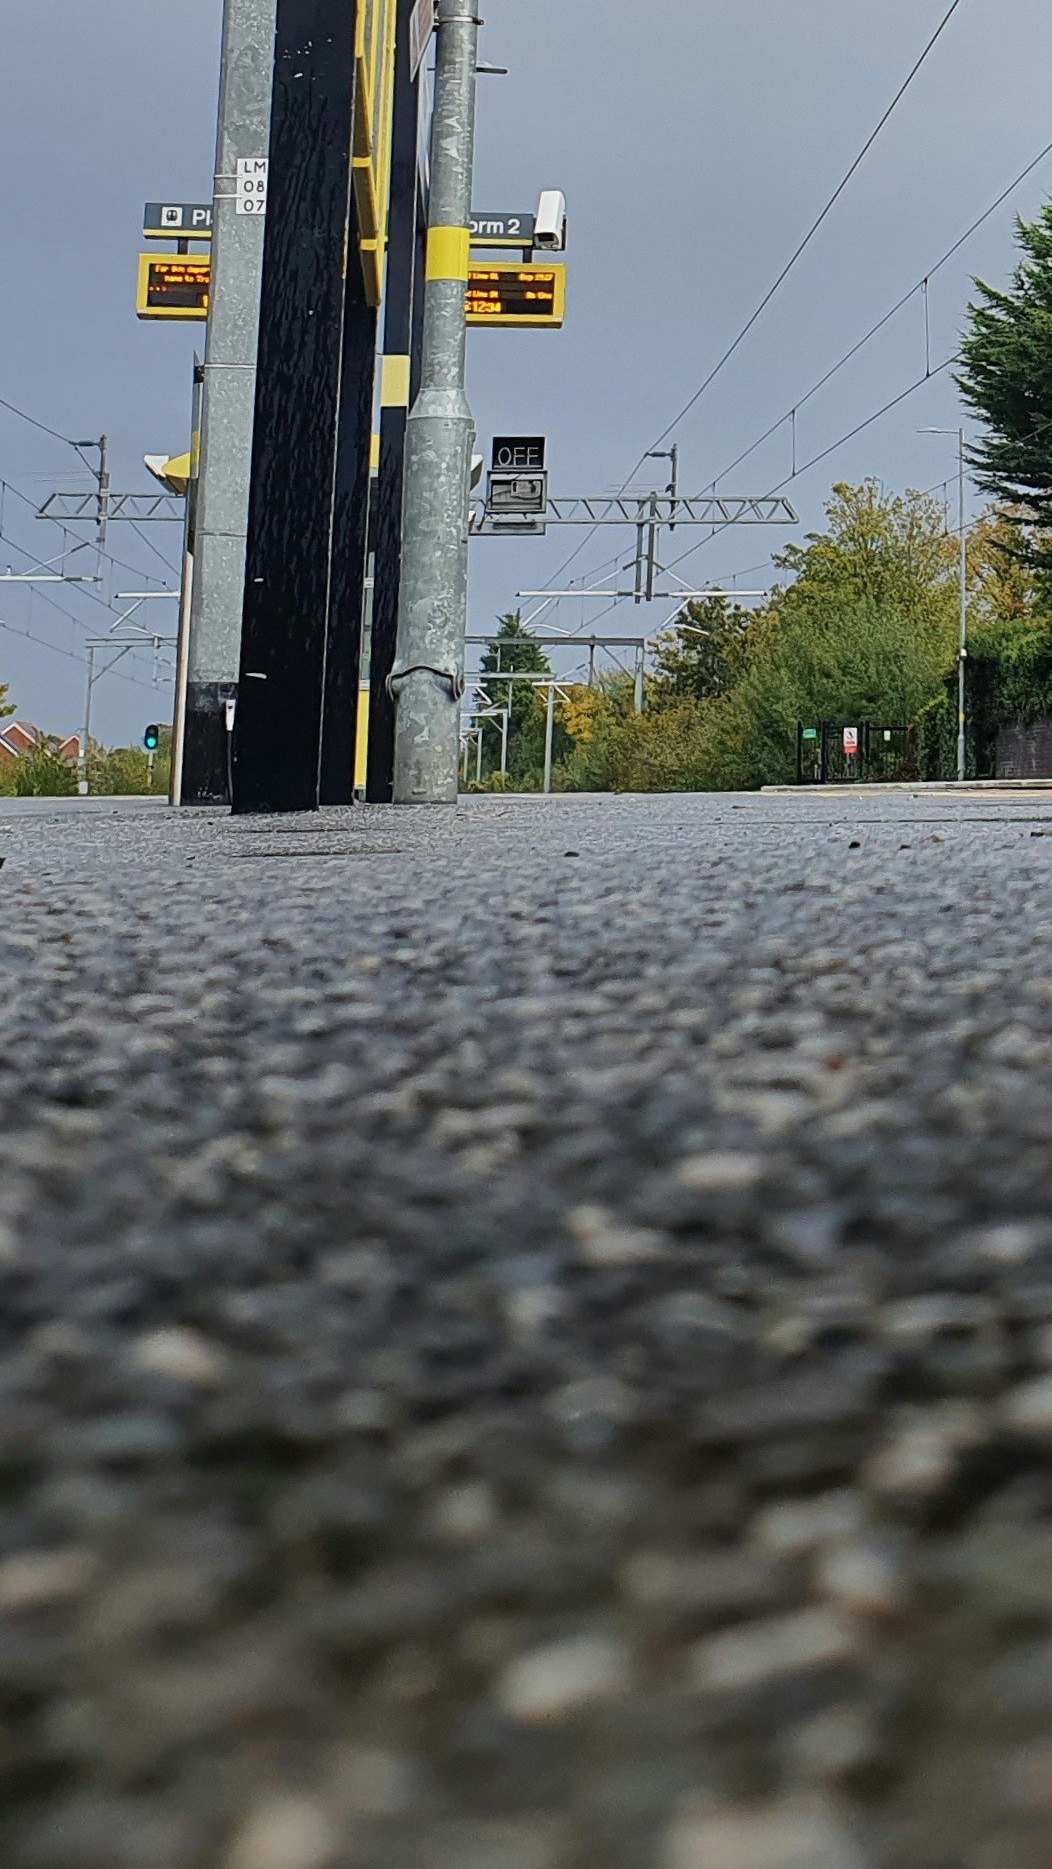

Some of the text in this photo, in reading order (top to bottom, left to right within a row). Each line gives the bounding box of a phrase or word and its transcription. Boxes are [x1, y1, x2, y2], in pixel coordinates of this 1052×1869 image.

[244, 161, 266, 174] LM
[243, 180, 265, 193] 08
[243, 199, 266, 212] 07
[192, 209, 212, 226] Pl
[507, 218, 520, 235] 2
[497, 446, 539, 466] OFF
